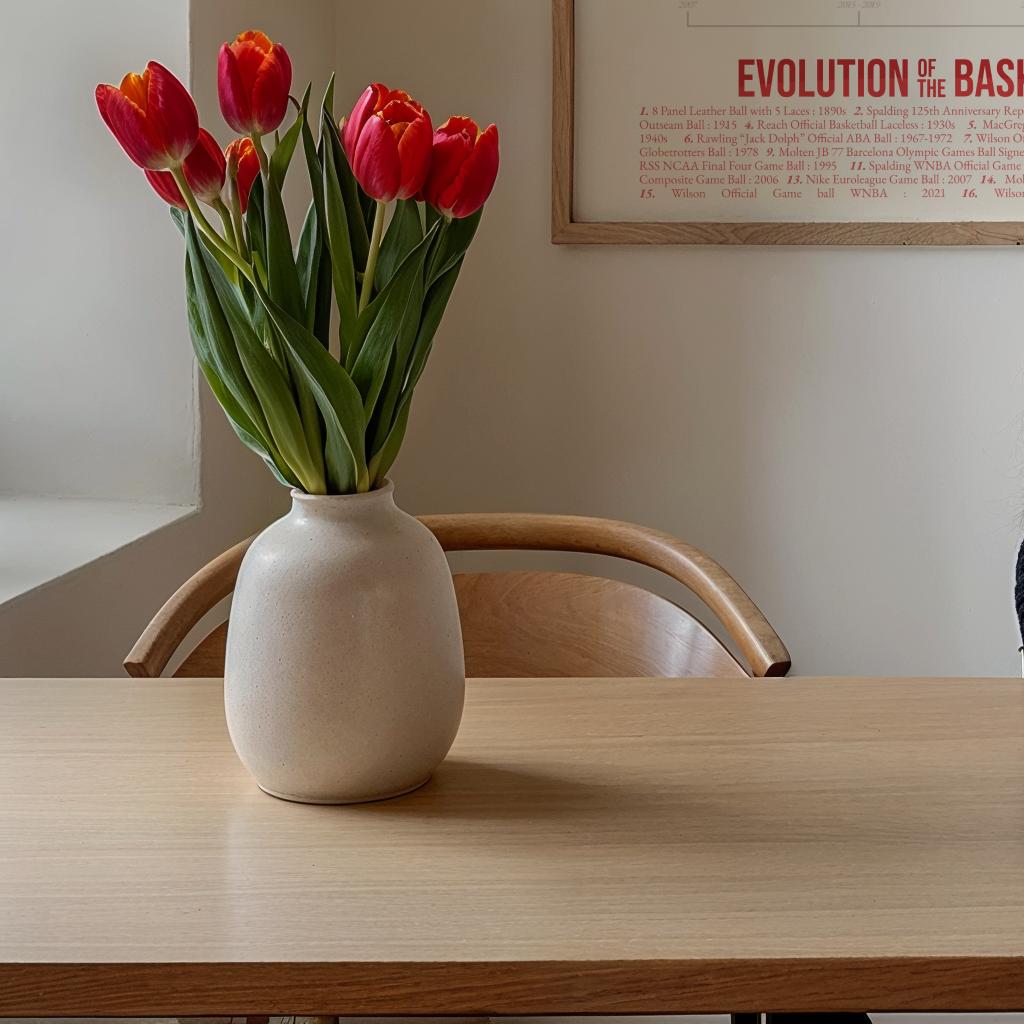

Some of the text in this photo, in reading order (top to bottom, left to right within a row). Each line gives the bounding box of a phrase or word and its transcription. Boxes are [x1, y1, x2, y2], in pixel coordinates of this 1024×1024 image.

[918, 58, 936, 77] OF
[738, 58, 908, 97] EVOLUTION
[917, 79, 946, 98] THE
[639, 106, 649, 116] 1.
[652, 106, 658, 116] 8
[661, 106, 687, 116] Panel
[689, 106, 726, 116] Leather
[729, 106, 747, 116] Ball
[750, 106, 772, 116] with
[775, 106, 781, 116] 5
[784, 106, 810, 116] Laces
[818, 106, 847, 116] 1890s
[853, 106, 863, 116] 2.
[866, 106, 909, 119] Spalding
[911, 106, 940, 116] 125th
[942, 106, 1001, 119] Anniversary
[639, 120, 683, 130] Outseam
[686, 120, 705, 130] Ball
[713, 120, 737, 130] 1915
[744, 120, 754, 130] 4.
[757, 120, 787, 130] Reach
[790, 120, 826, 130] Official
[829, 120, 878, 130] Basketball
[880, 120, 919, 130] Laceless
[927, 120, 955, 130] 1930s
[967, 120, 977, 130] 5.
[639, 133, 668, 144] 1940s
[683, 133, 694, 144] 6.
[696, 133, 737, 147] Rawling
[807, 133, 844, 144] Official
[846, 133, 871, 144] ABA
[874, 133, 892, 144] Ball
[901, 133, 952, 144] 1967-1972
[963, 133, 973, 144] 7.
[976, 133, 1010, 144] Wilson
[639, 147, 705, 157] Globetrotters
[708, 147, 726, 157] Ball
[735, 147, 759, 157] 1978
[766, 147, 775, 157] 9.
[778, 147, 814, 157] Molten
[816, 147, 829, 160] JB
[831, 147, 844, 157] 77
[846, 147, 893, 157] Barcelona
[896, 147, 939, 160] Olympic
[941, 147, 975, 157] Games
[978, 147, 996, 157] Ball
[639, 160, 660, 171] RSS
[663, 160, 699, 171] NCAA
[702, 160, 726, 171] Final
[729, 160, 752, 171] Four
[754, 160, 784, 171] Game
[786, 160, 805, 171] Ball
[813, 160, 837, 171] 1995
[850, 160, 866, 171] 11.
[868, 160, 911, 174] Spalding
[913, 160, 951, 171] WNBA
[953, 160, 989, 171] Official
[992, 160, 1021, 171] Game
[639, 174, 694, 188] Composite
[696, 174, 725, 185] Game
[728, 174, 746, 185] Ball
[754, 174, 779, 185] 2006
[786, 174, 802, 185] 13.
[805, 174, 830, 185] Nike
[832, 174, 887, 188] Euroleague
[889, 174, 919, 185] Game
[921, 174, 939, 185] Ball
[948, 174, 973, 185] 2007
[980, 174, 996, 185] 14.
[640, 188, 656, 198] 15.
[671, 188, 706, 198] Wilson
[721, 188, 757, 198] Official
[772, 188, 802, 198] Game
[817, 188, 835, 198] ball
[849, 188, 888, 198] WNBA
[922, 188, 945, 198] 2021
[962, 188, 978, 198] 16.
